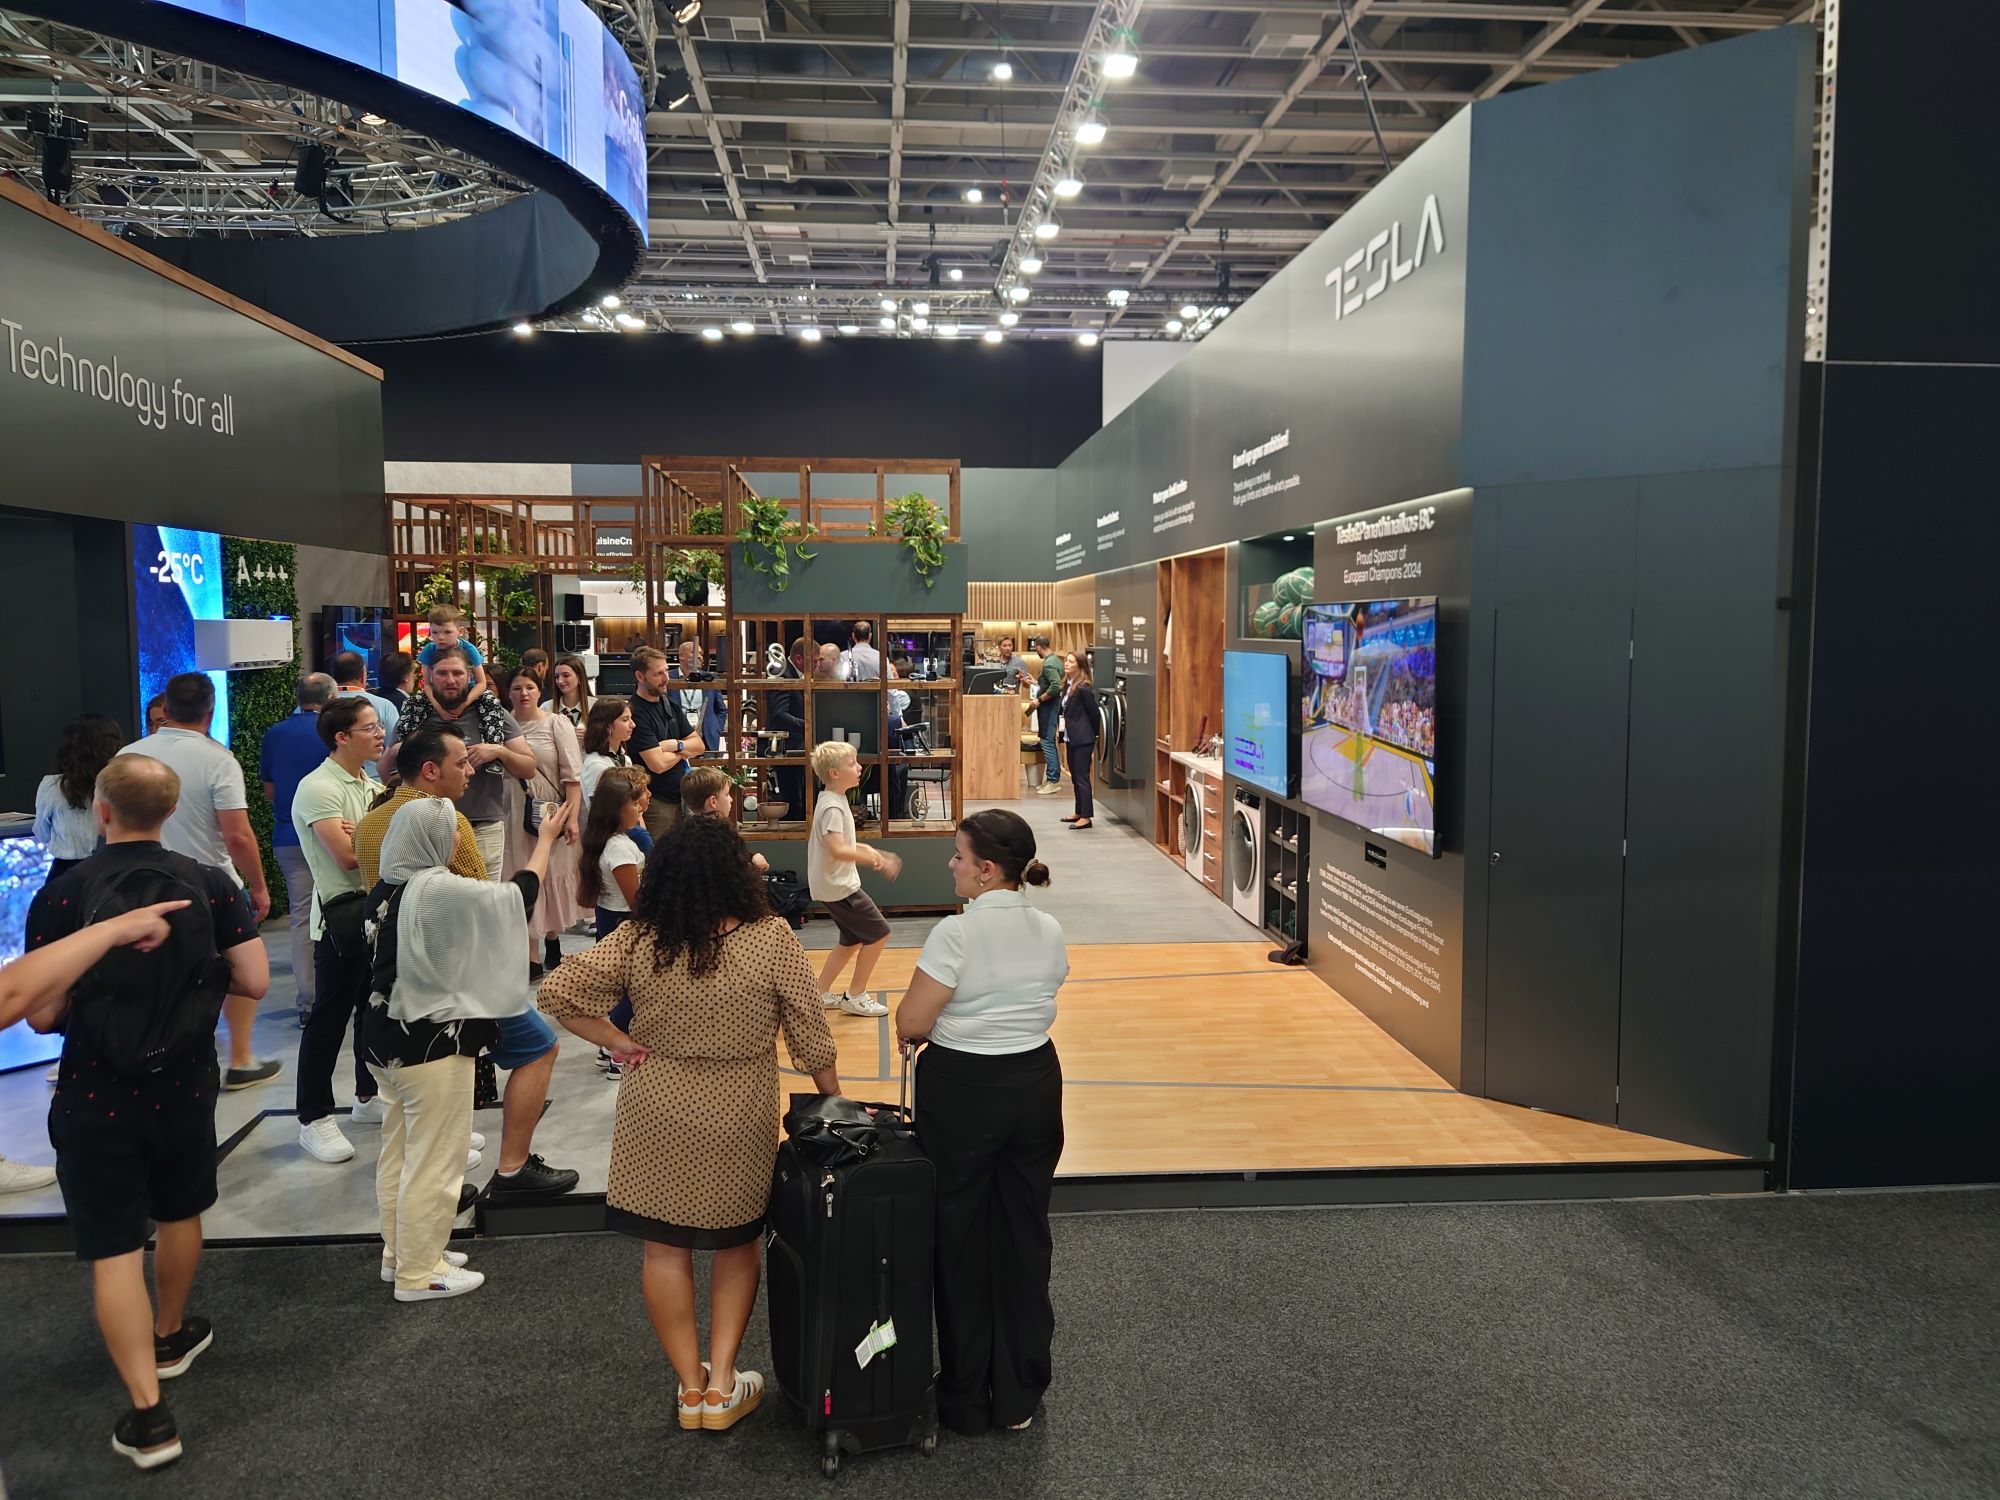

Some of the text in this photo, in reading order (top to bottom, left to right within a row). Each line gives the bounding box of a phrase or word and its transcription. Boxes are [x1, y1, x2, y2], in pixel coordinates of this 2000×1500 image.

[1325, 193, 1444, 321] TESLA
[1, 318, 234, 436] Technology for all
[1360, 512, 1418, 541] Panathinaikos
[1357, 543, 1407, 567] Proud Sponsor of
[1344, 562, 1422, 587] European Champions 2024
